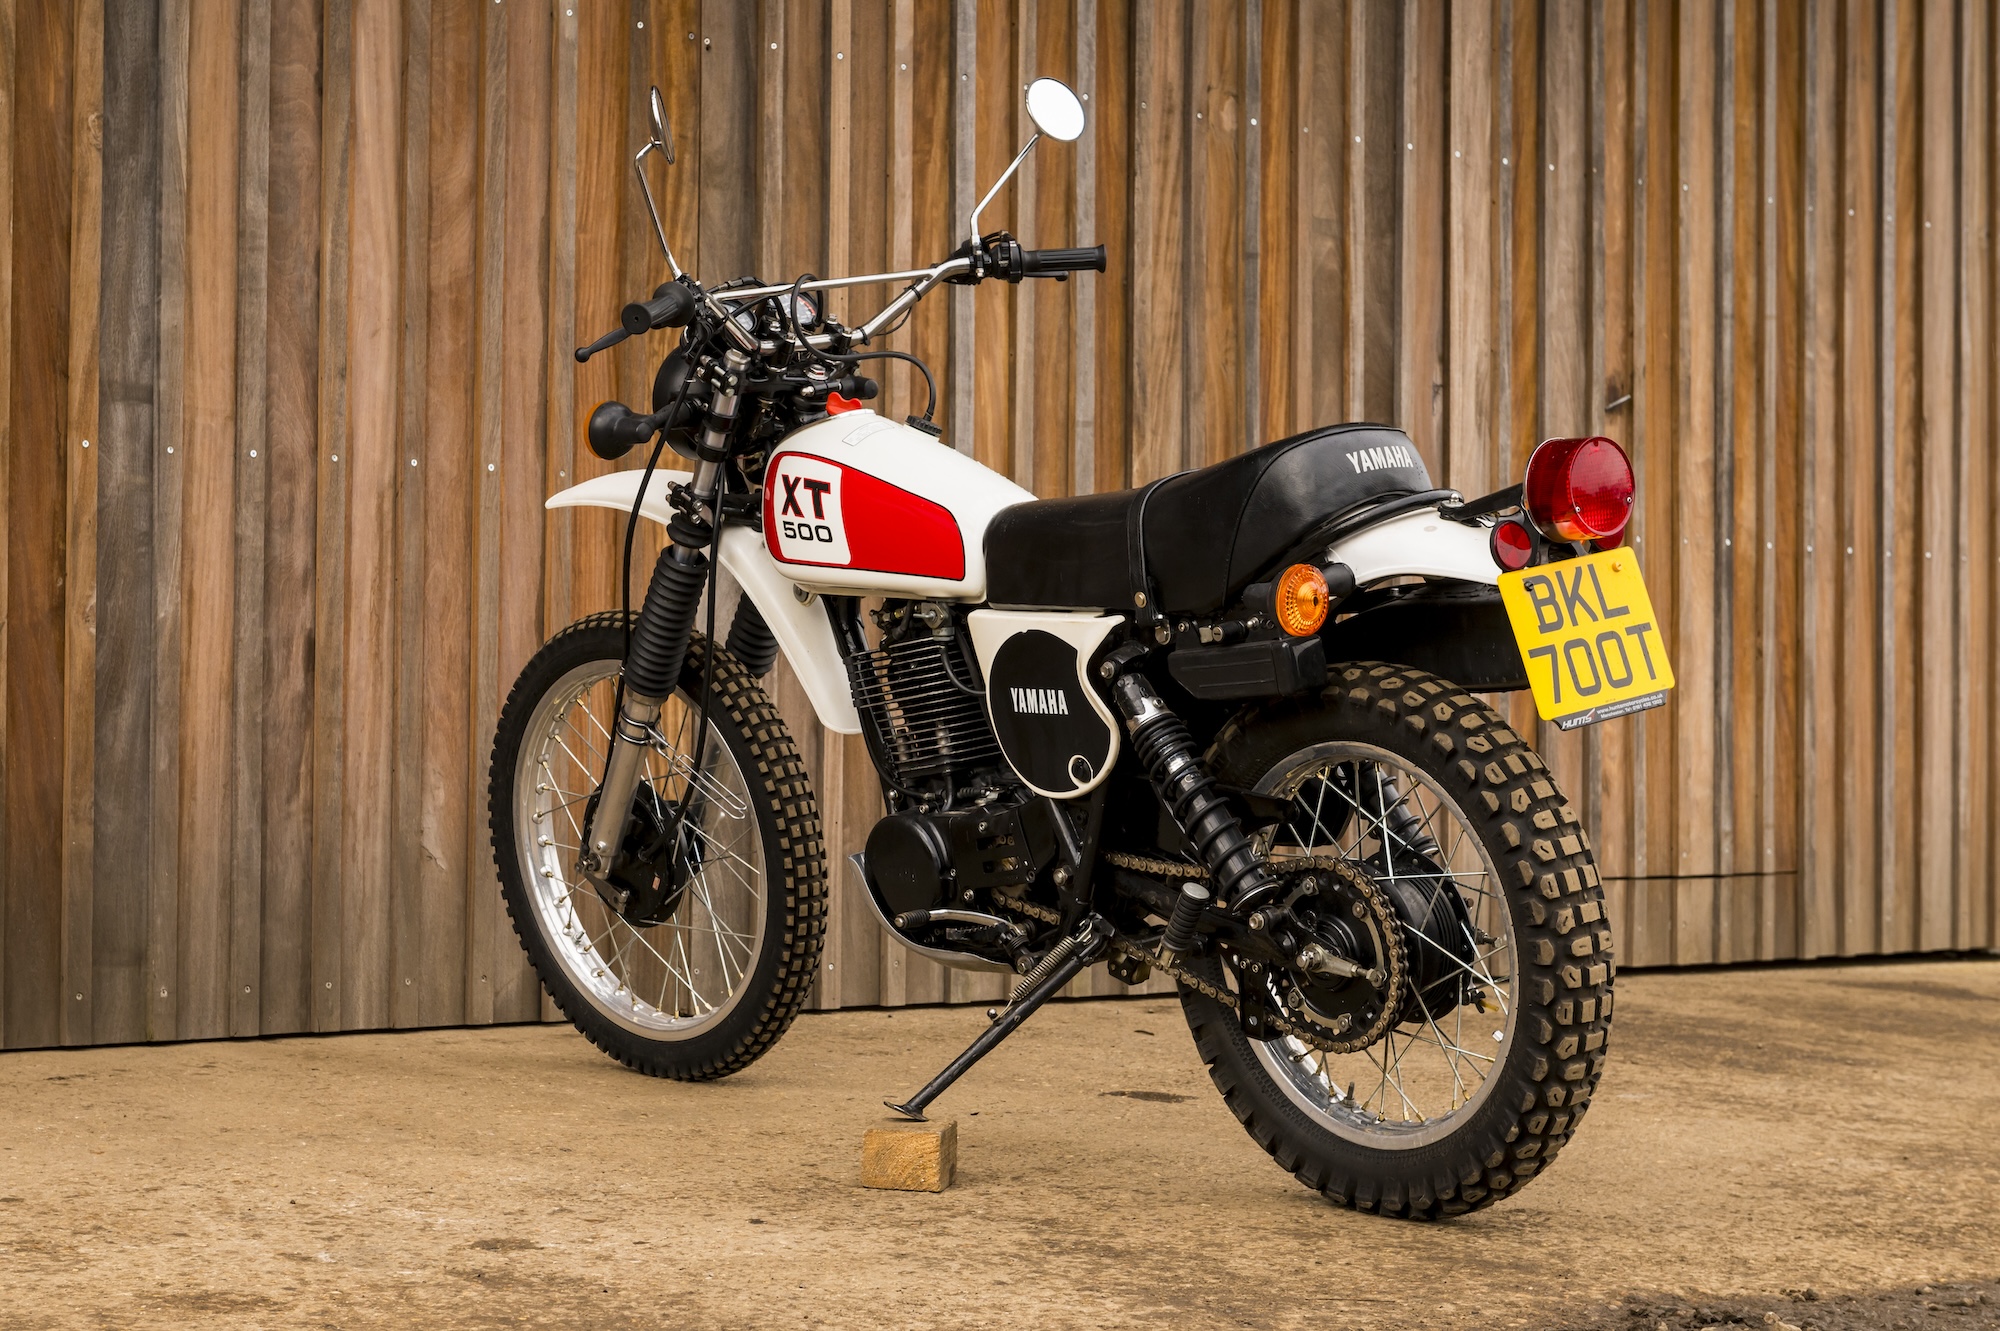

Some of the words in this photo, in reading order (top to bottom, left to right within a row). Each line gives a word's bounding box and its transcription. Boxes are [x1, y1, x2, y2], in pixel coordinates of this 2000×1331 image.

[1345, 445, 1414, 474] YAMAHA
[781, 474, 831, 520] XT
[782, 520, 833, 543] 500
[1522, 563, 1630, 635] BKL
[1527, 622, 1657, 705] 700T
[1010, 687, 1069, 716] YAMAHA
